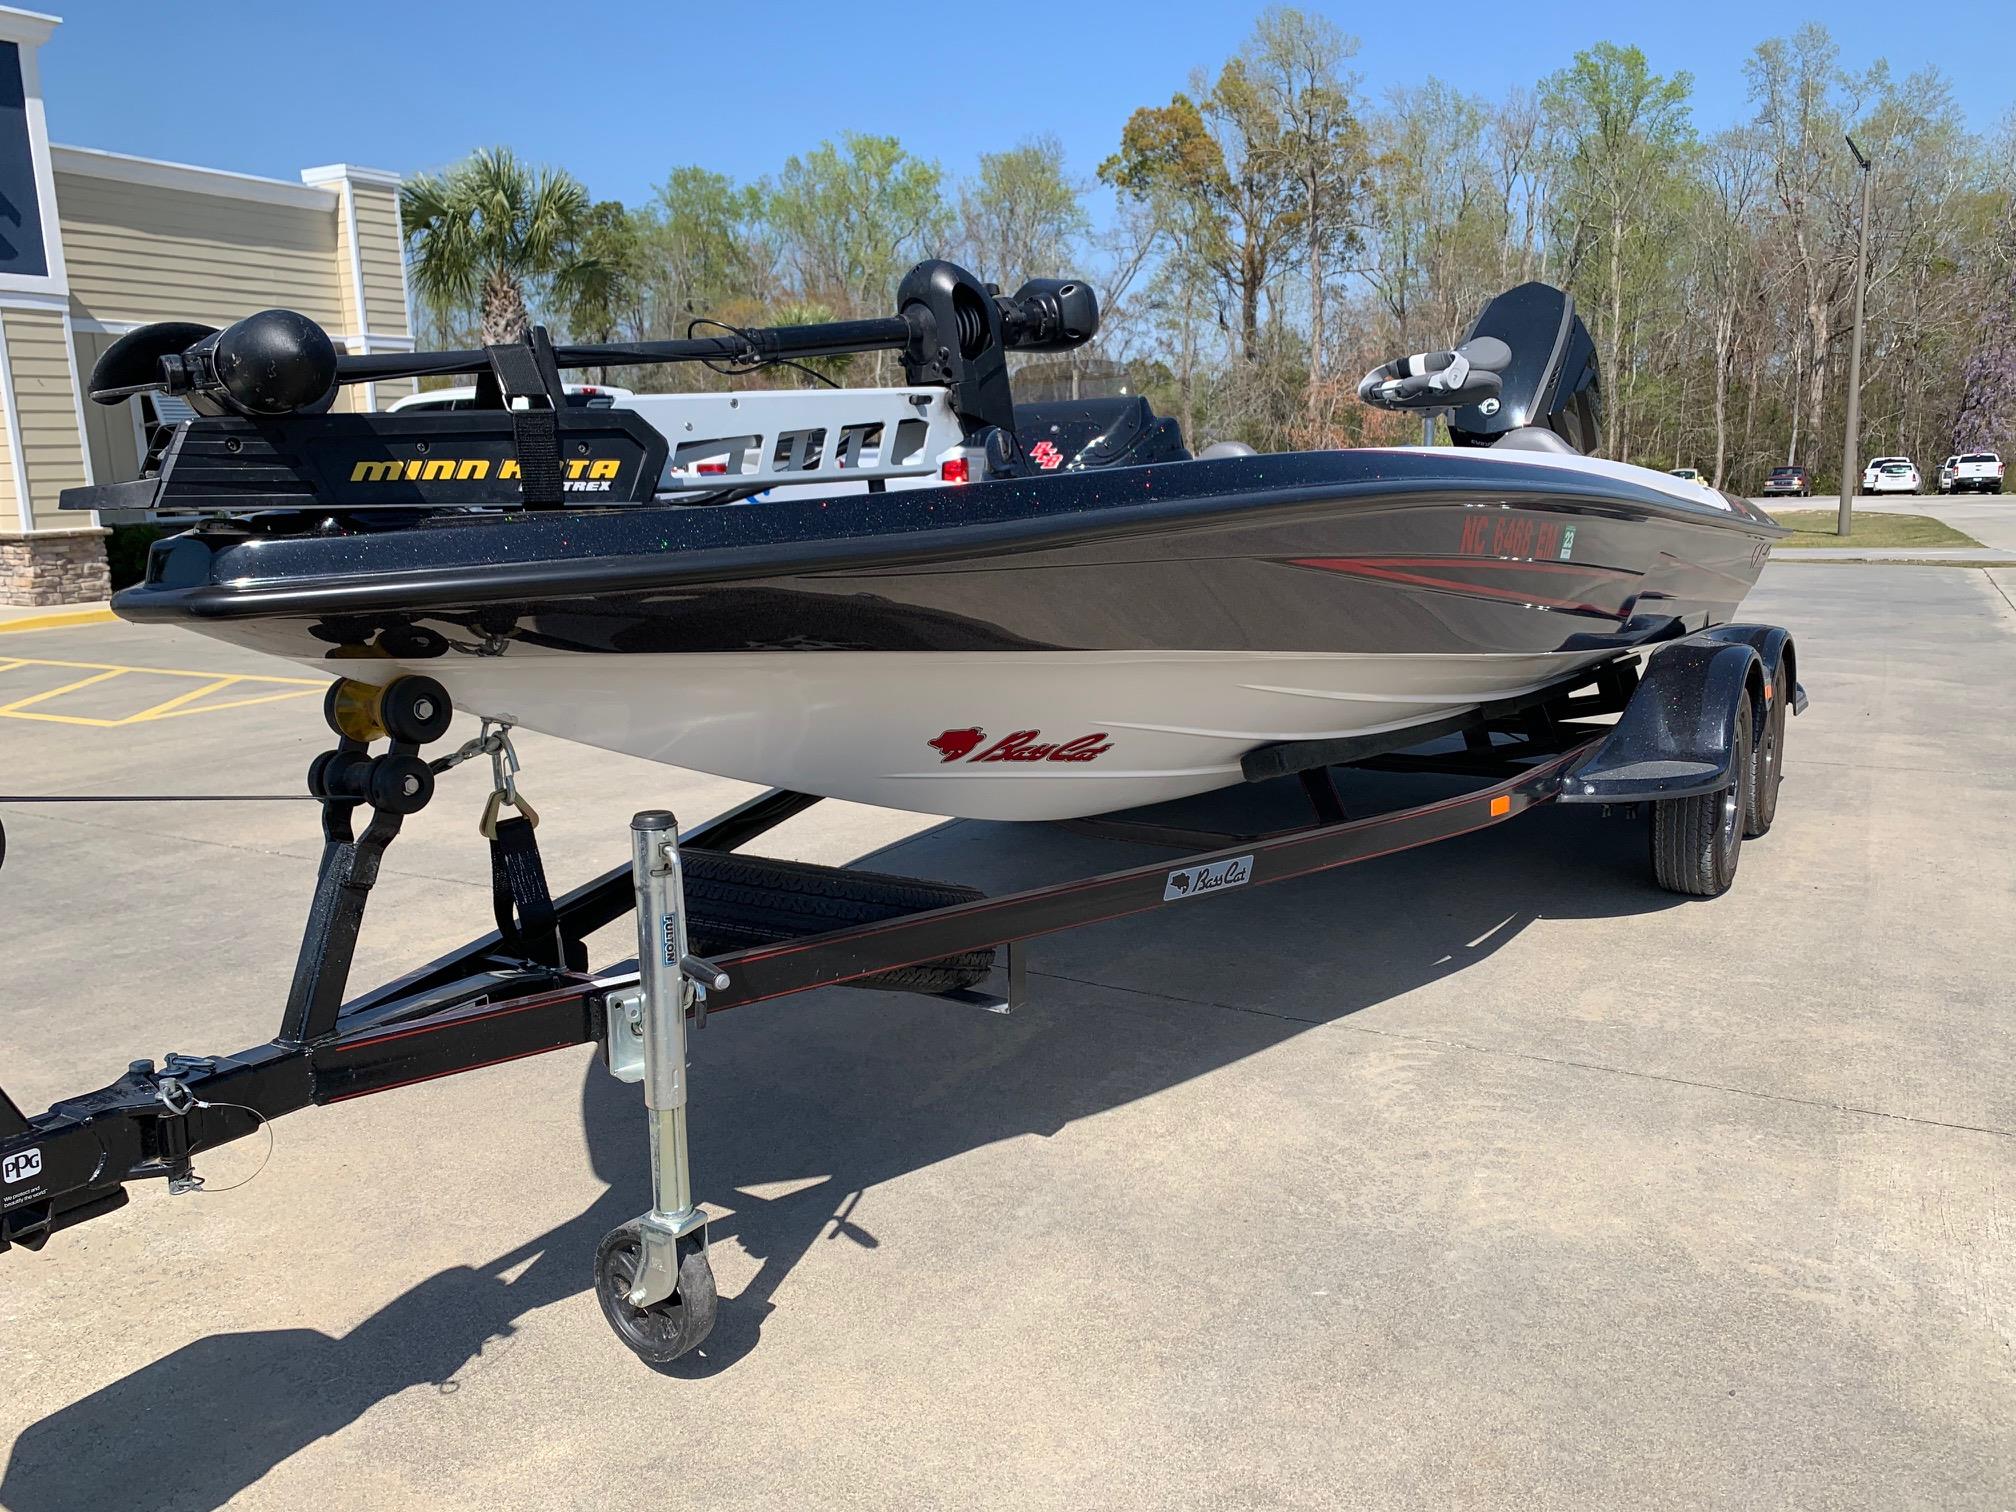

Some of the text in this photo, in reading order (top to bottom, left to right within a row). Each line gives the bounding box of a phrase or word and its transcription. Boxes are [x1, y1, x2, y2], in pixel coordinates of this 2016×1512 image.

[350, 459, 621, 482] MINN KTA
[1460, 514, 1488, 554] NC
[1563, 531, 1575, 548] 23
[967, 728, 1115, 763] Bass Cat
[1191, 861, 1247, 893] Bass Cat
[664, 915, 675, 962] FULTON
[5, 1154, 39, 1178] PPG
